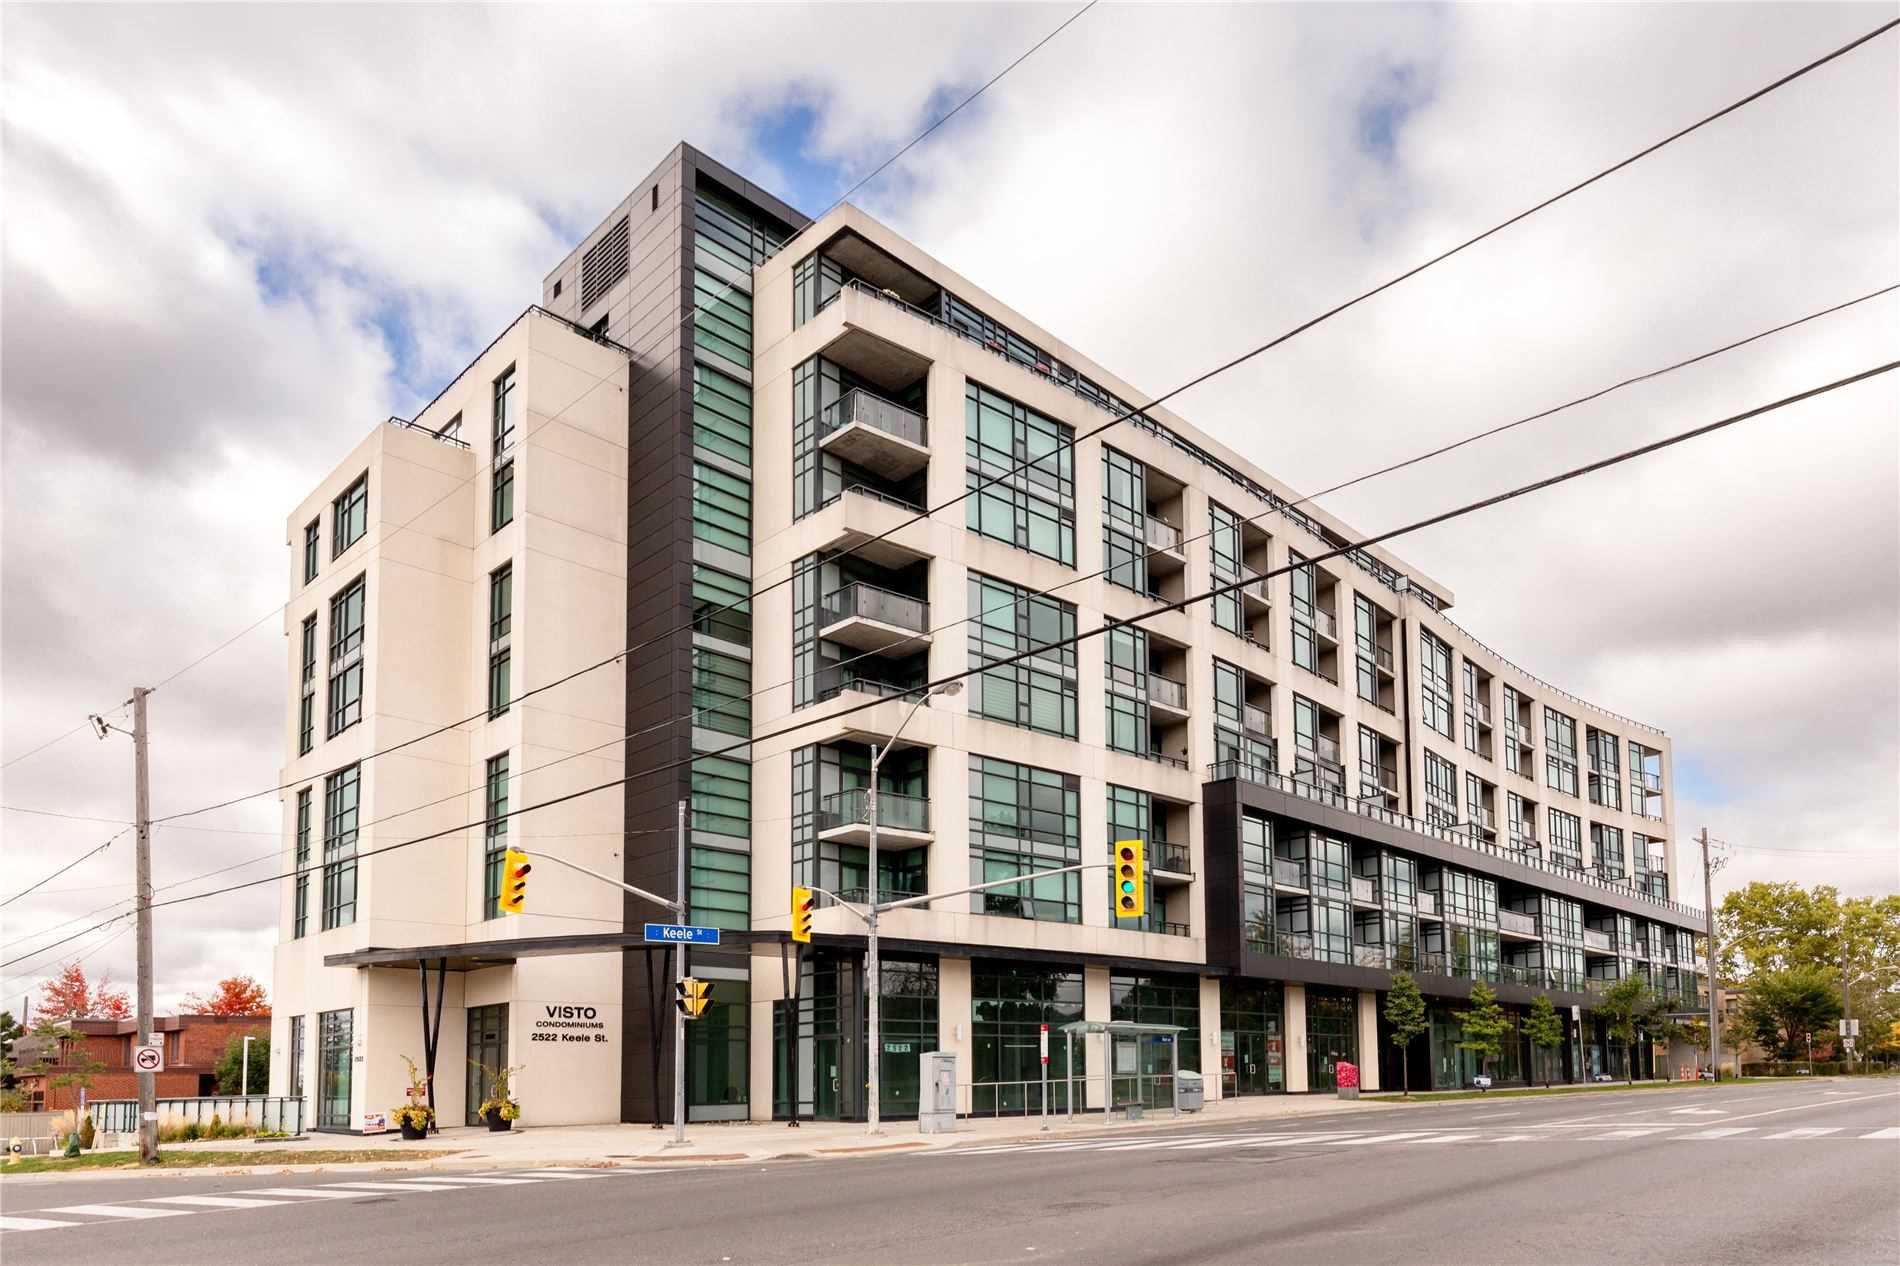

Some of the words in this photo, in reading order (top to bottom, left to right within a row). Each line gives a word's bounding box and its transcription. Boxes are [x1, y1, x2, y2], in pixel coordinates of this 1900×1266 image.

[663, 927, 693, 940] Keele
[545, 1005, 597, 1020] VISTO
[535, 1020, 604, 1029] CONDOMINIUMS
[531, 1033, 558, 1042] 2522
[561, 1033, 591, 1043] Keele
[594, 1034, 609, 1043] St.
